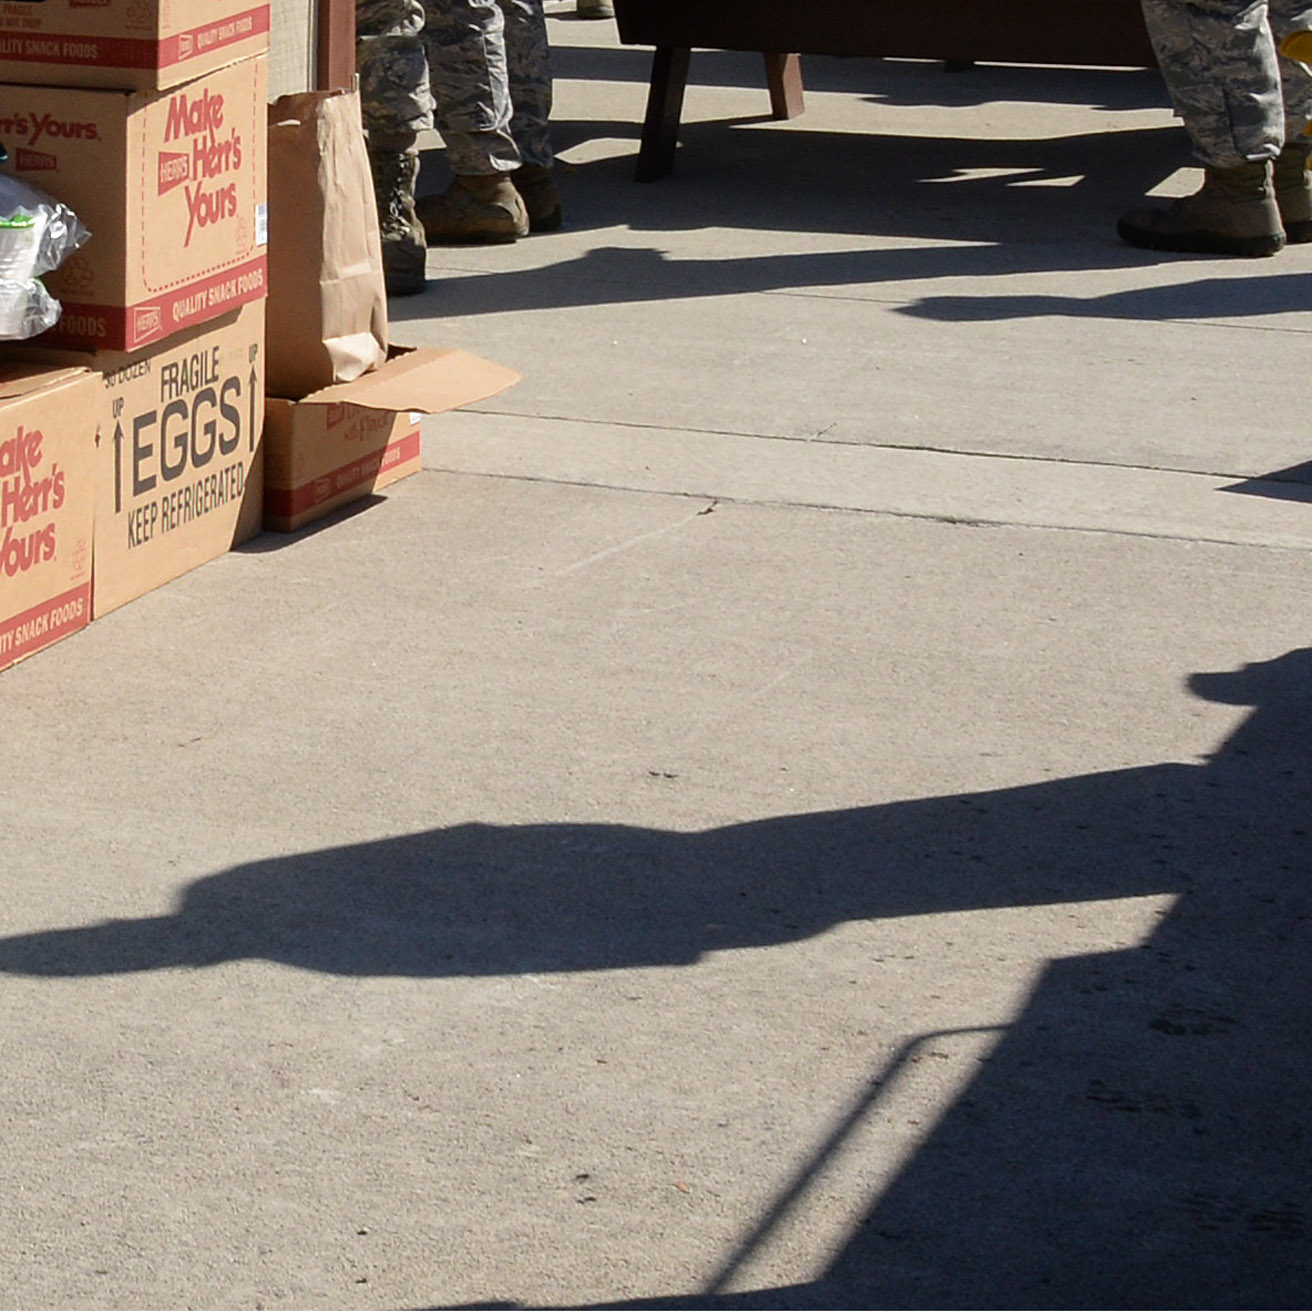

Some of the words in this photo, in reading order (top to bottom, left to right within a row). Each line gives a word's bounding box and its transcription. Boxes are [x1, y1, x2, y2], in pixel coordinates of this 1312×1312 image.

[25, 39, 61, 56] SNACK
[63, 42, 99, 59] FOODS
[163, 88, 224, 145] Make
[192, 126, 242, 181] Herr's
[172, 290, 208, 323] QUALITY
[208, 278, 237, 307] SNACK
[237, 268, 263, 292] FOODS
[161, 346, 220, 403] FRAGILE
[112, 396, 125, 419] UP
[133, 375, 242, 498] EGGS
[1, 462, 66, 528] Herr's
[128, 500, 159, 550] KEEP
[161, 461, 244, 534] REFRIGERATED
[14, 613, 49, 649] SNACK
[49, 597, 84, 630] FOODS
